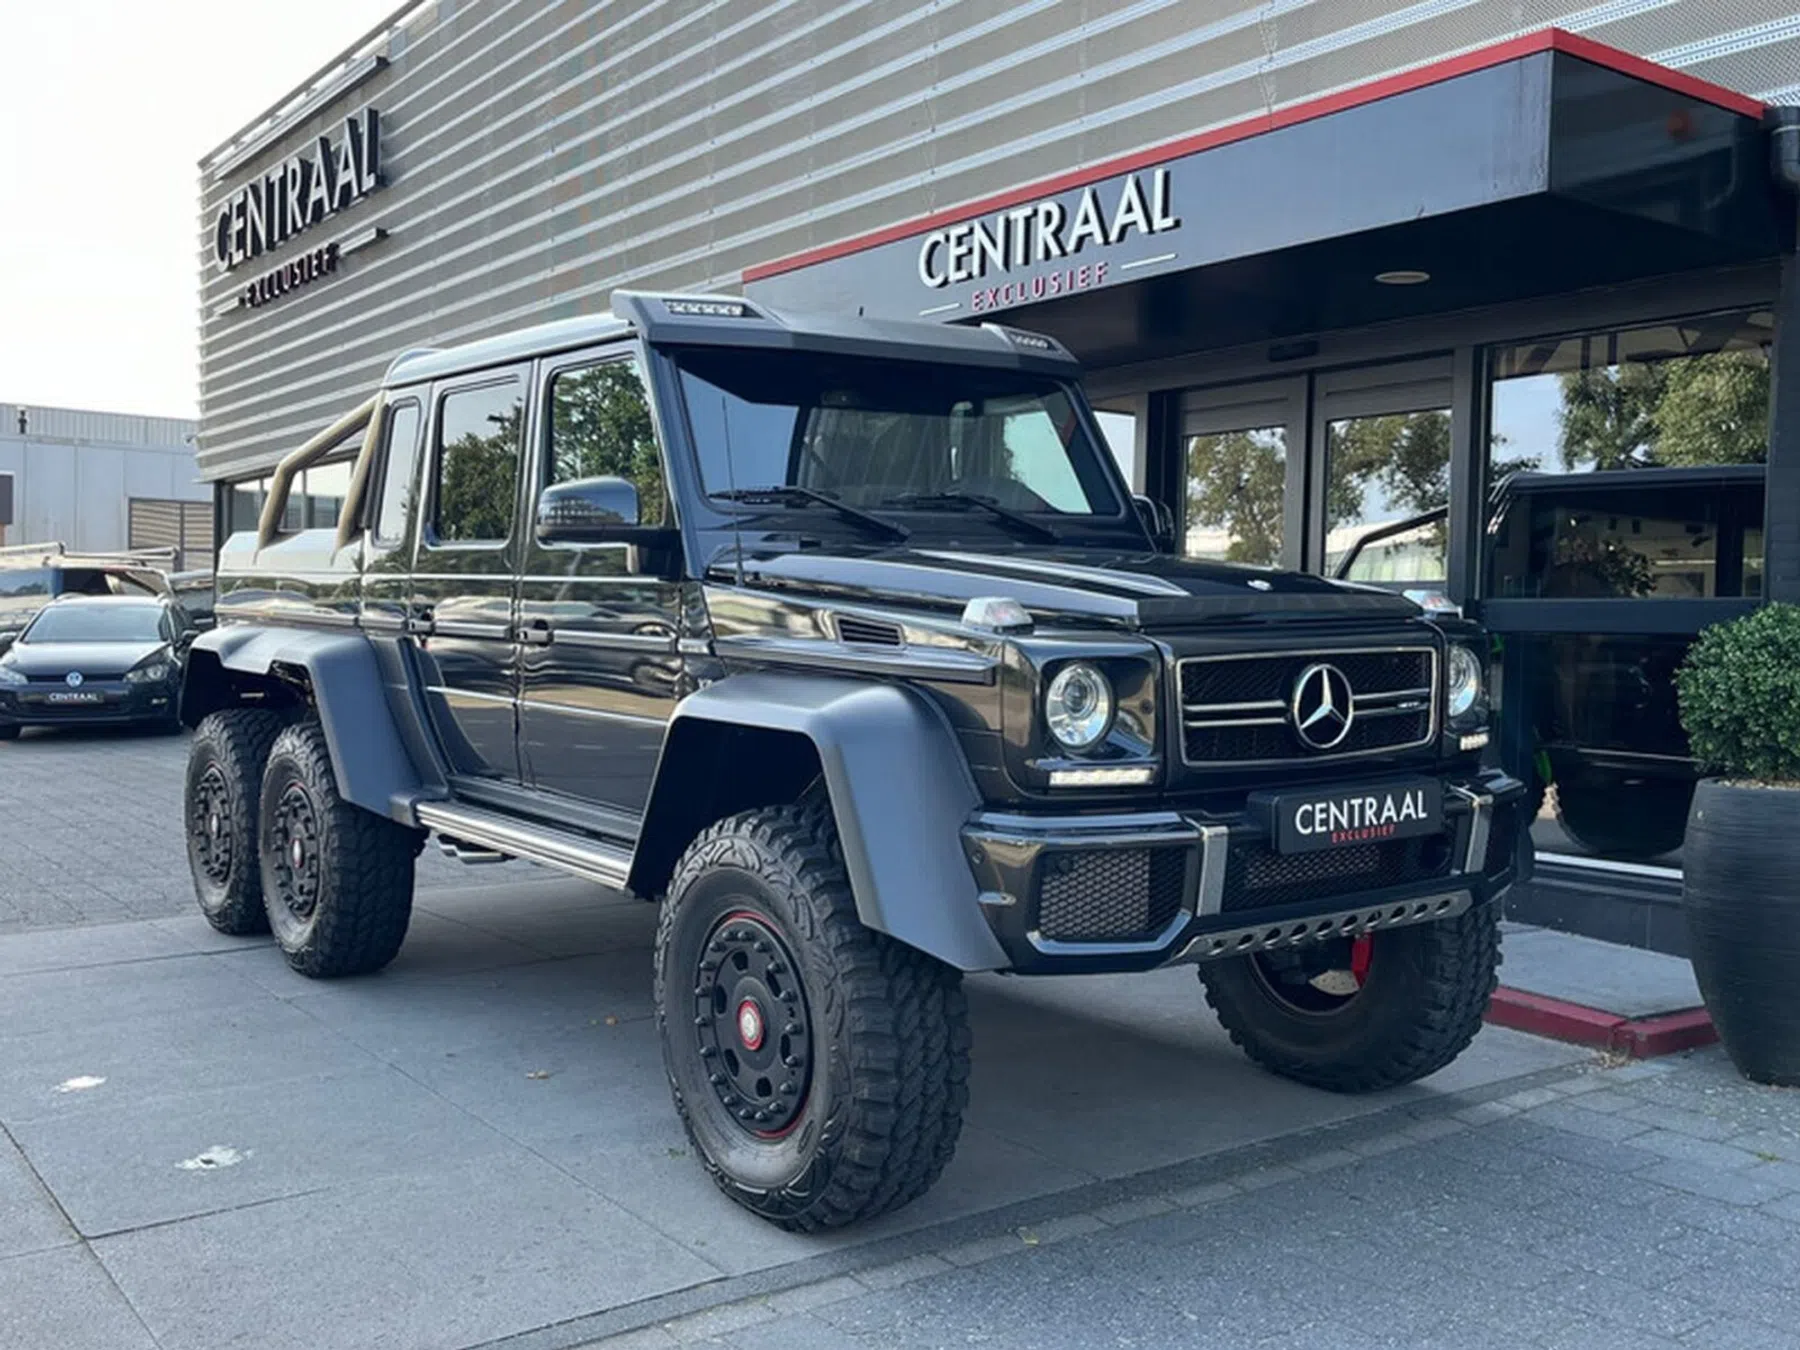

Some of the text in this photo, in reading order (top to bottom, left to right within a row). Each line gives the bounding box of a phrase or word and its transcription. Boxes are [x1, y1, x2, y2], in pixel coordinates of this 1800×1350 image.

[214, 107, 379, 272] CENTRAAL
[918, 168, 1179, 288] CENTRAAL
[246, 243, 340, 307] EXCLUSIEF
[971, 261, 1109, 312] EXCLUSIEF
[48, 692, 99, 702] CENTRAAL
[1294, 789, 1428, 835] CENTRAAL
[1331, 823, 1396, 844] EXCLUSIEF
